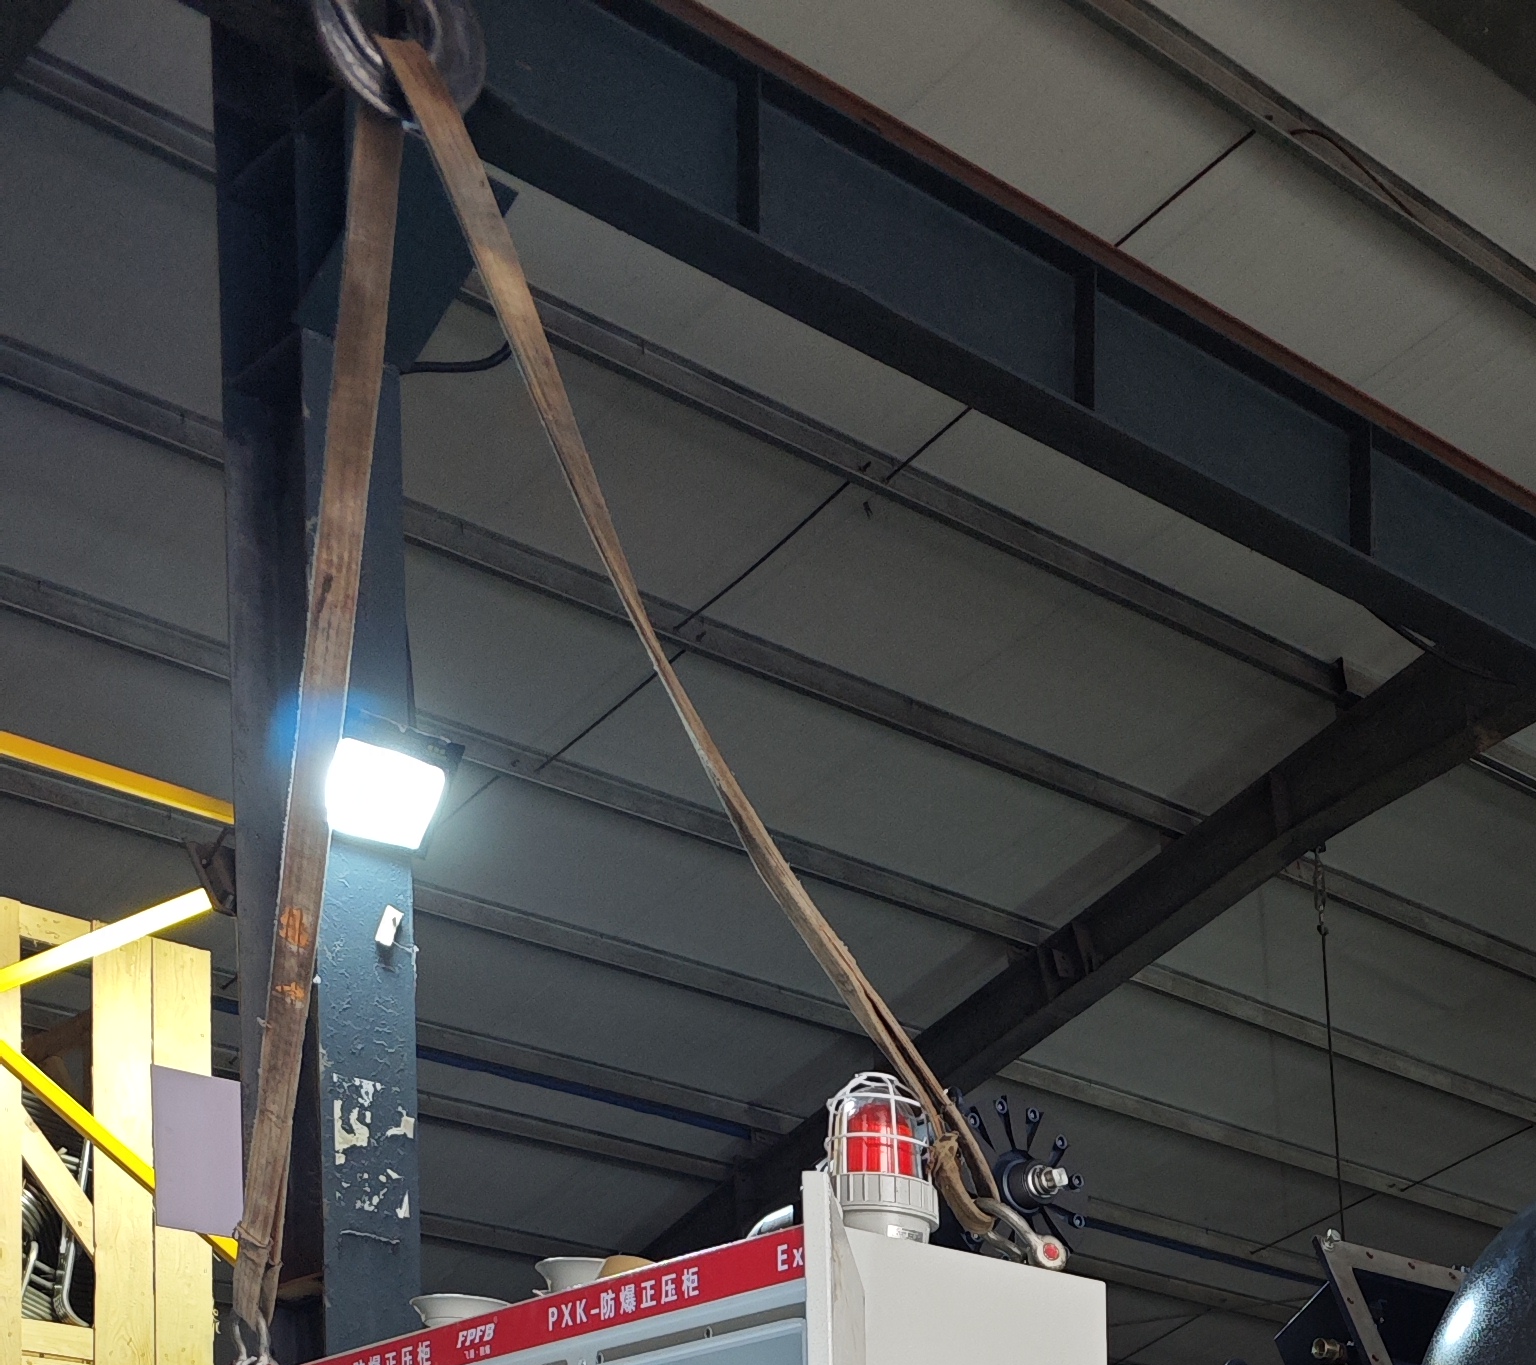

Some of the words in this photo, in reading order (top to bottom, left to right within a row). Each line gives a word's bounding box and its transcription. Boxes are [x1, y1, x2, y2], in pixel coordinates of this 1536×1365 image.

[456, 1323, 495, 1348] FPFB
[548, 1267, 699, 1331] PXK-防爆正压柜
[777, 1244, 804, 1272] Ex
